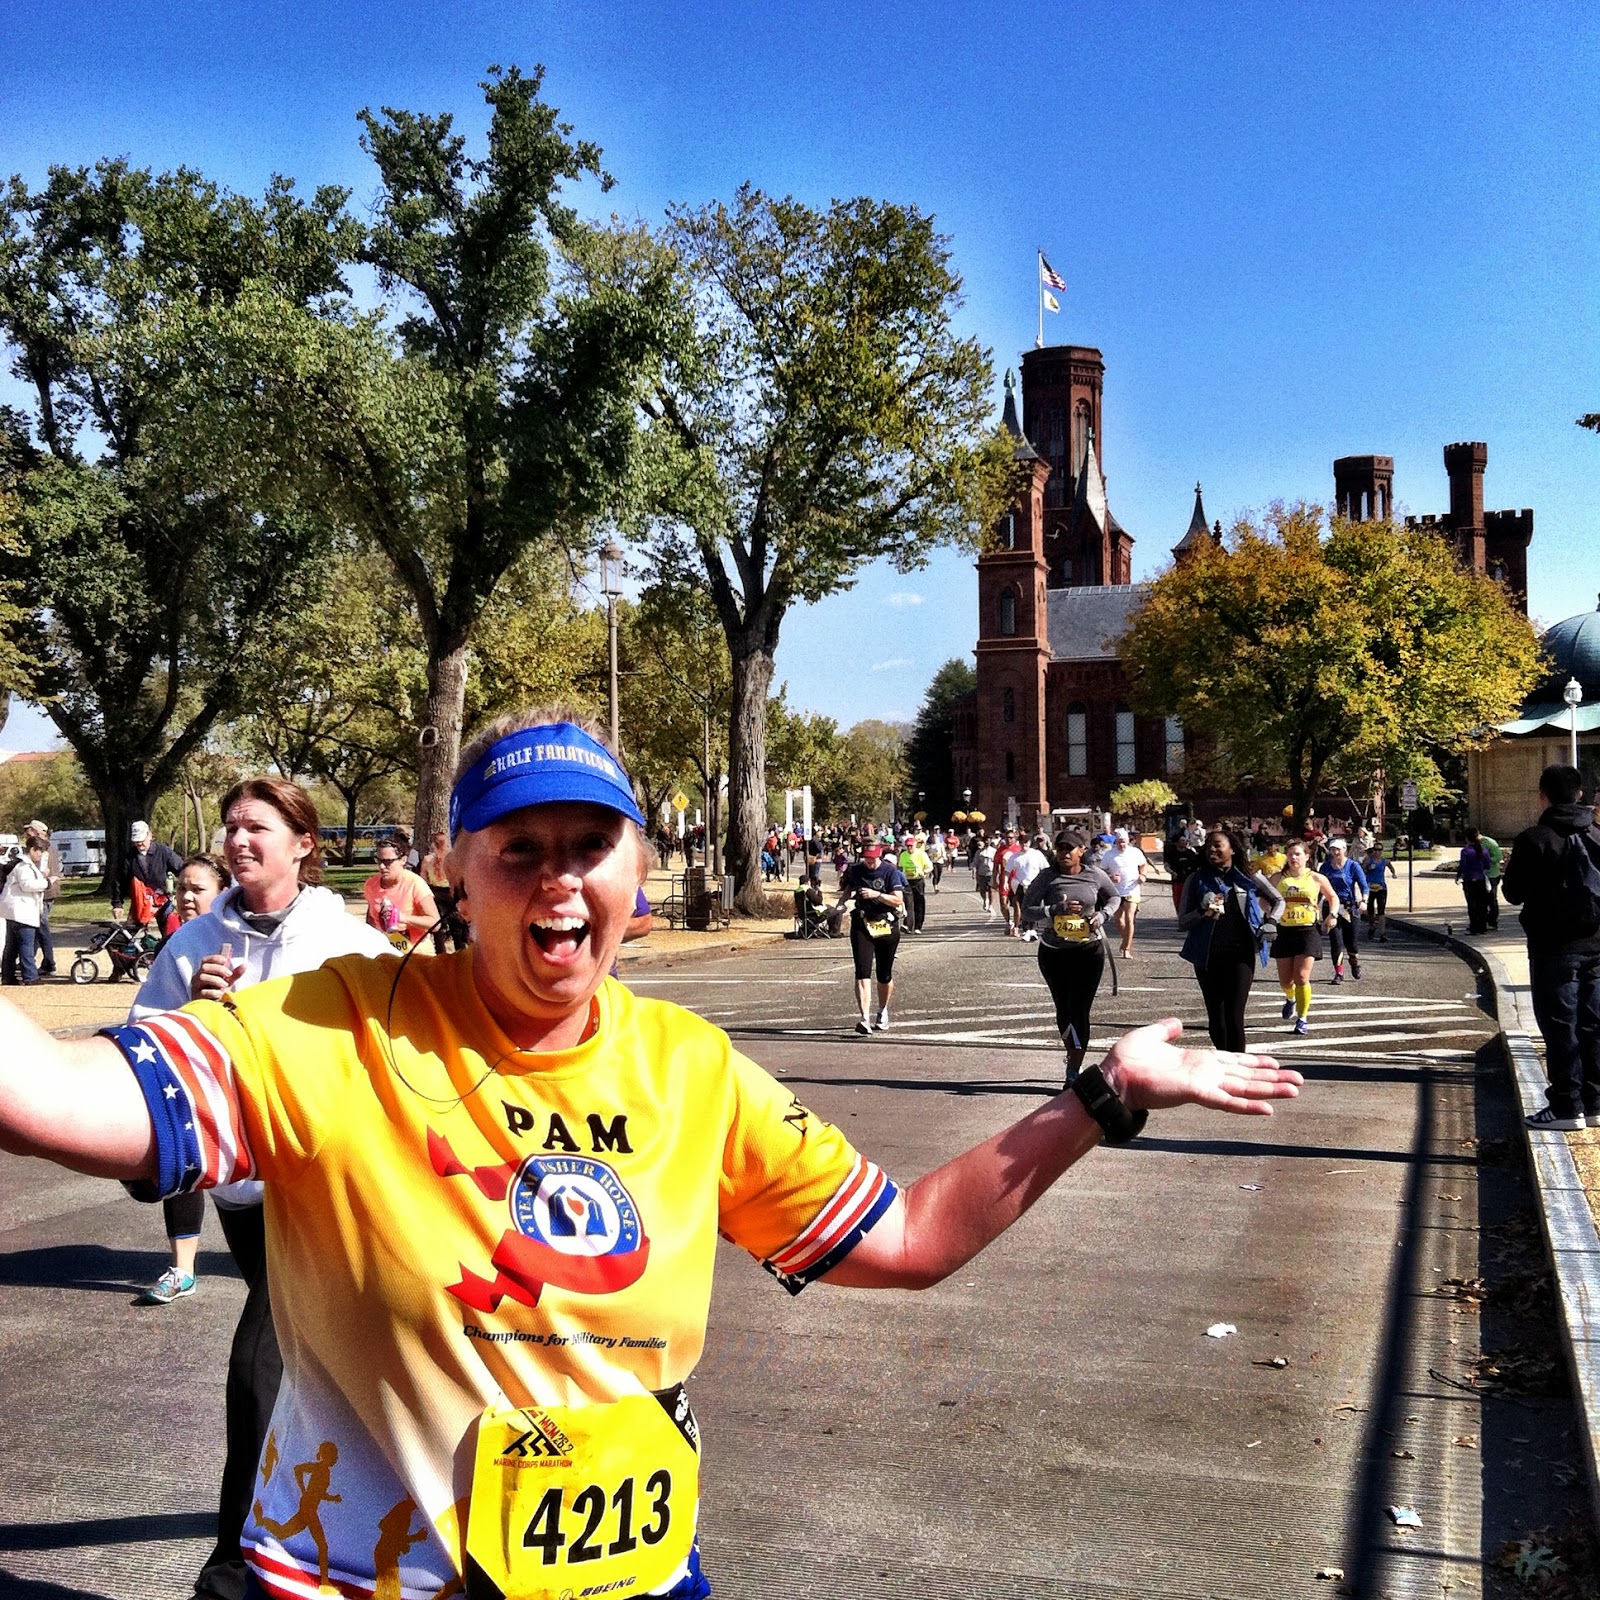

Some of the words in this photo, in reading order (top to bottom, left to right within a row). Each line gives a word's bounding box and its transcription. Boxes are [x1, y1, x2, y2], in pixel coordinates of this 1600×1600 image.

[496, 746, 533, 773] HALF
[501, 1100, 634, 1153] PAM
[463, 1325, 544, 1344] Champions
[543, 1333, 569, 1347] for
[571, 1331, 617, 1348] Military
[617, 1336, 667, 1349] Families
[538, 1415, 561, 1440] MCM
[493, 1458, 517, 1468] MARINE
[518, 1460, 539, 1469] CORPS
[540, 1460, 573, 1468] MARATHON
[523, 1469, 672, 1565] 4213
[579, 1576, 637, 1597] BOEING
